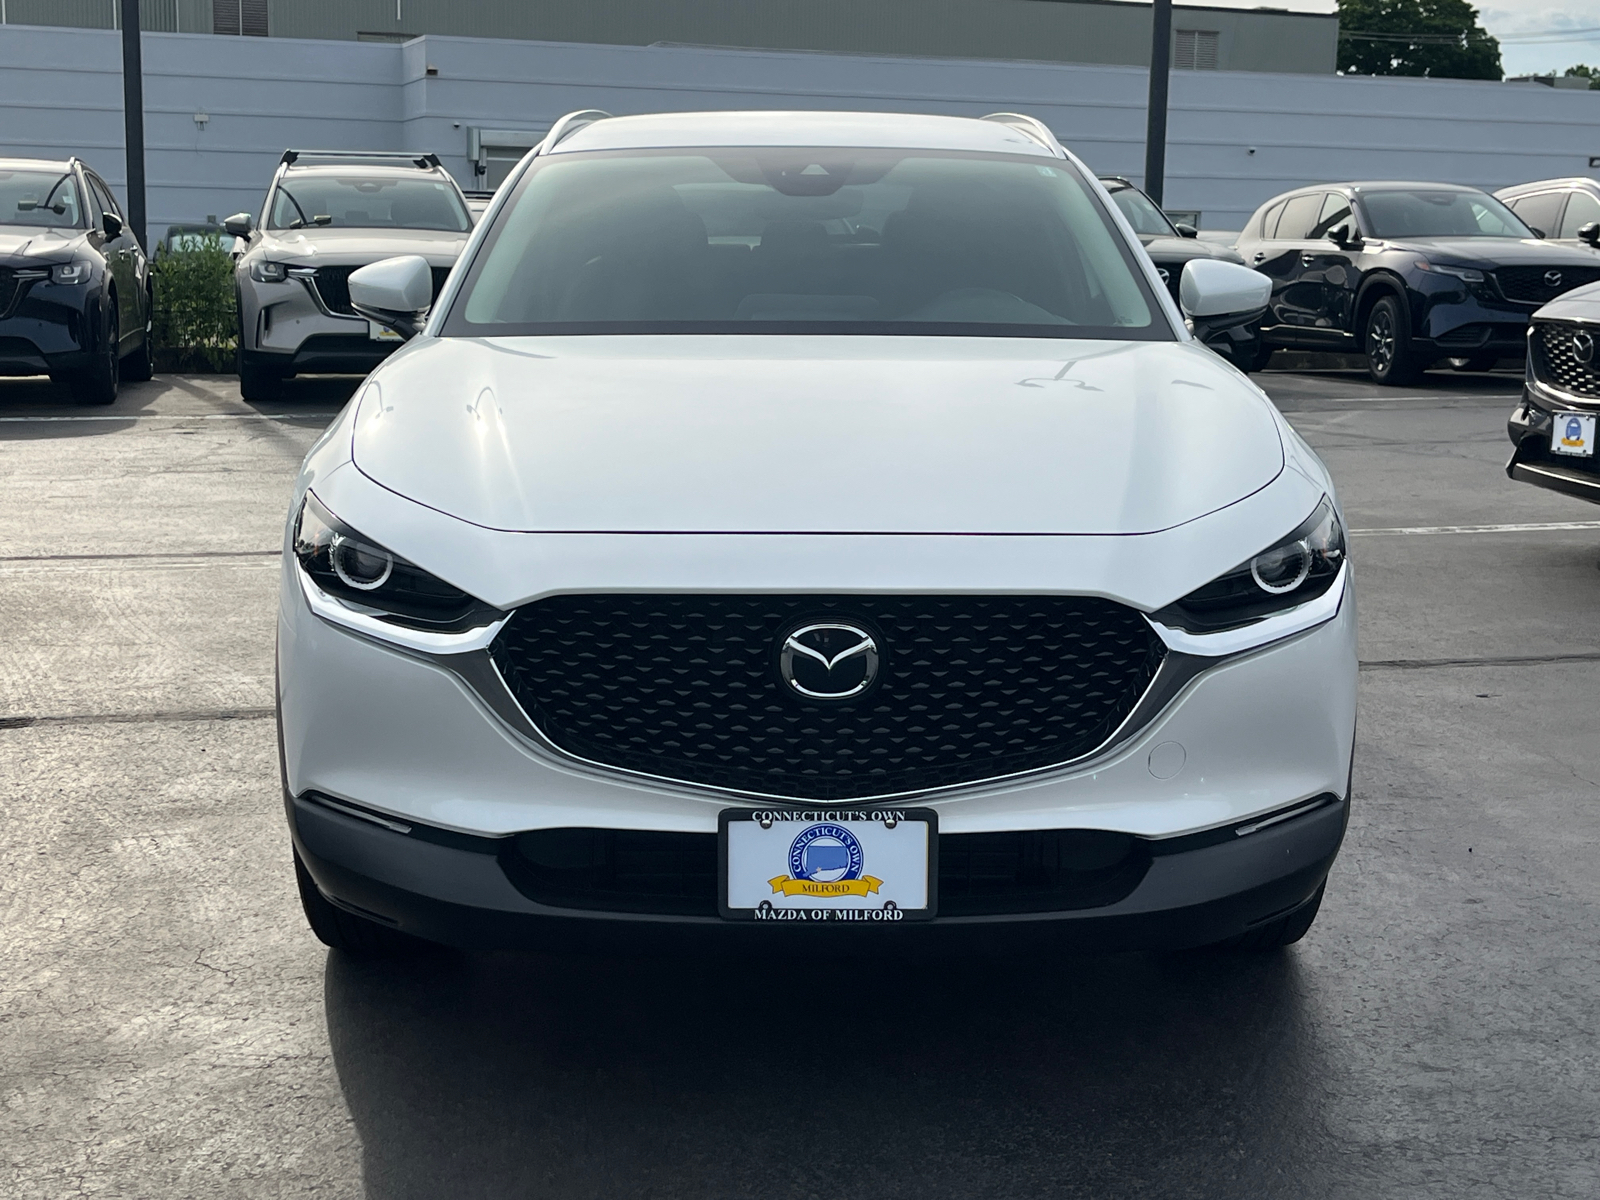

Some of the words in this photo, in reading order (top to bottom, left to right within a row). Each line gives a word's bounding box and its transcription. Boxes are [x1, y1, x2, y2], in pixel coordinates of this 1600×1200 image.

[752, 811, 867, 821] CONNECTICUT'S
[871, 811, 906, 821] OWN
[792, 827, 853, 872] CONNECTICUT'S
[850, 845, 860, 872] OWN
[802, 884, 850, 893] MILFORD
[754, 910, 807, 921] MAZDA
[812, 910, 832, 921] OF
[835, 910, 904, 921] MILFORD
